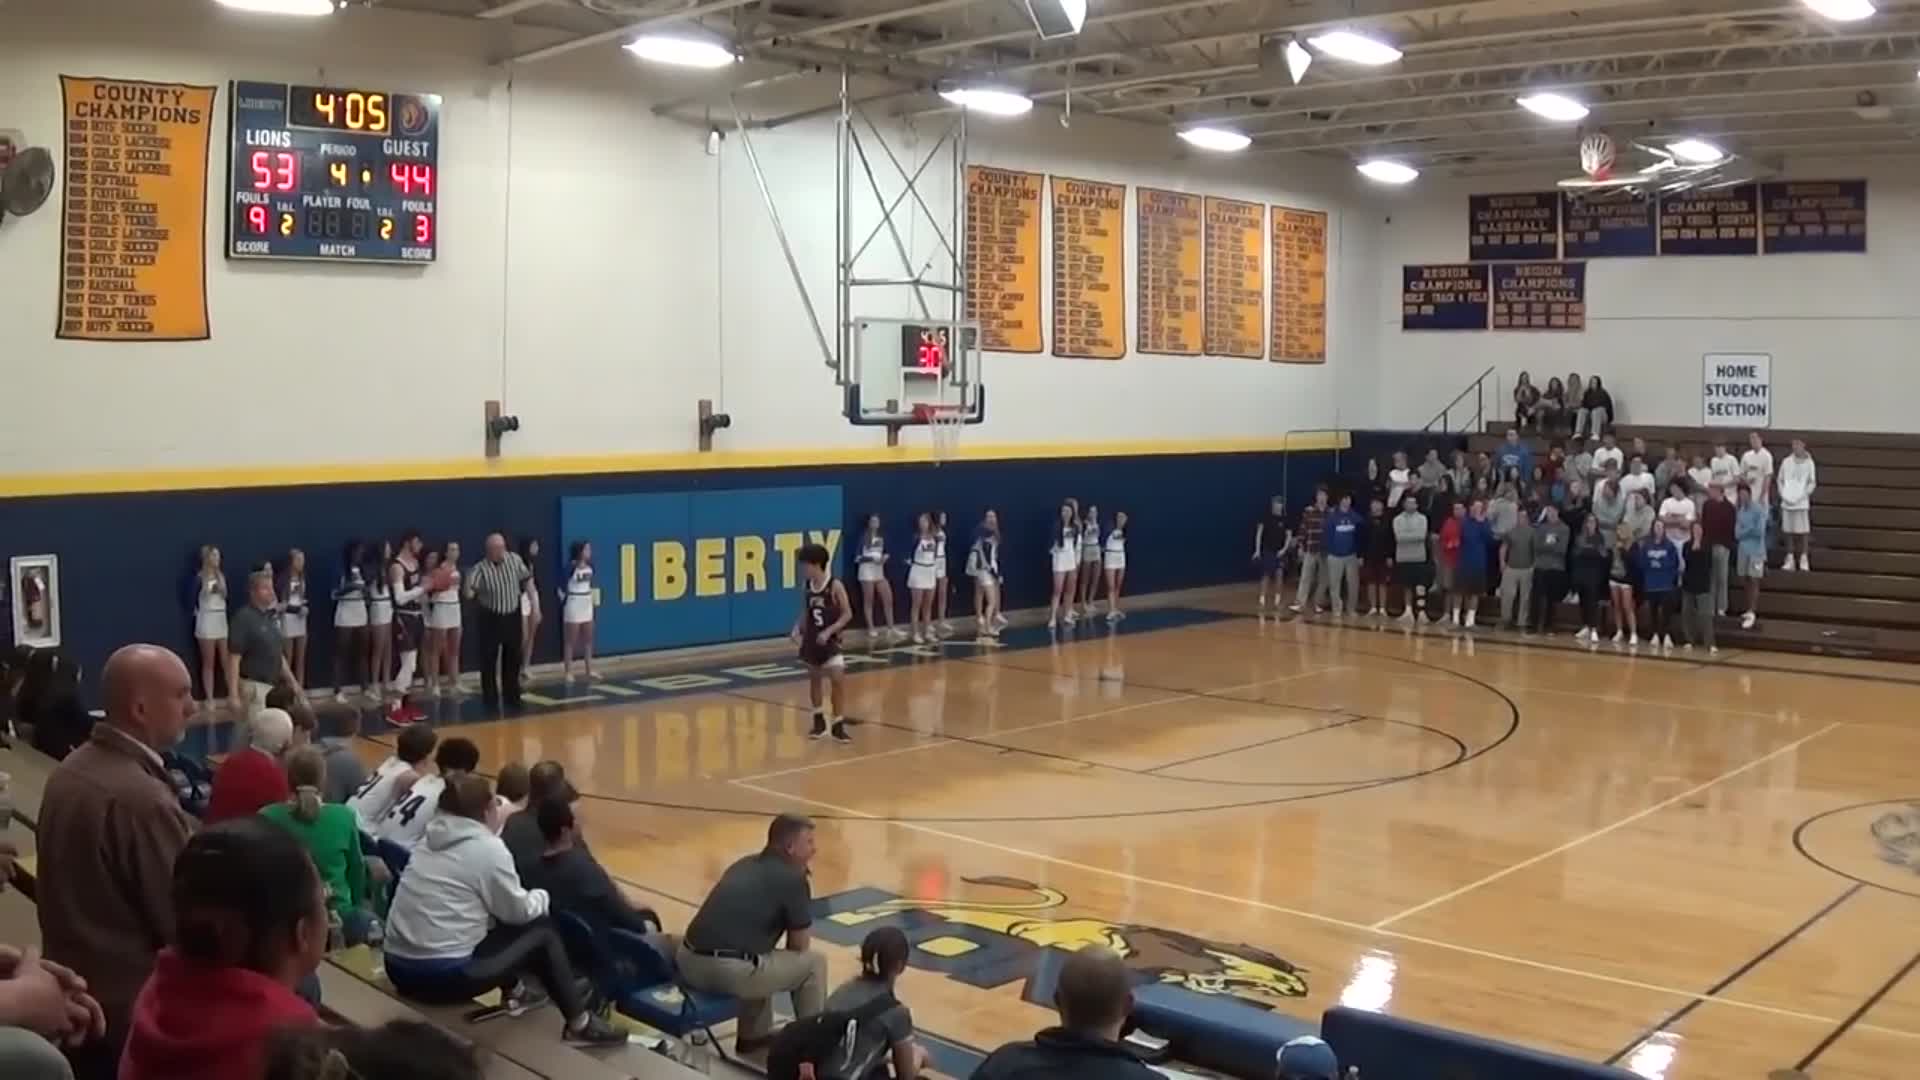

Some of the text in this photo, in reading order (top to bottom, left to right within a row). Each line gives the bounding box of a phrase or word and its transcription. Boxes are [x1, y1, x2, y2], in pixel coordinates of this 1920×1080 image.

[94, 84, 184, 105] COUNTY
[75, 102, 200, 124] CHAMPIONS
[246, 129, 291, 147] LIONS
[320, 143, 357, 156] PERIOD
[383, 139, 430, 157] GUEST
[252, 151, 294, 189] 53
[330, 163, 347, 186] 4
[391, 163, 430, 194] 44
[978, 170, 1028, 186] COUNTY
[236, 191, 270, 204] FOULS
[970, 183, 1037, 201] CHAMPIONS
[1066, 182, 1111, 198] COUNTY
[303, 195, 371, 210] PLAYER FOUL
[402, 200, 433, 212] FOULS
[1057, 194, 1119, 210] CHAMPIONS
[1667, 201, 1749, 212] CHAMPIONS
[250, 206, 265, 233] 9
[280, 213, 293, 235] 2
[1479, 221, 1548, 233] BASEBALL
[380, 219, 393, 240] 2
[416, 215, 429, 242] 3
[236, 241, 270, 253] SCORE
[319, 243, 355, 256] MATCH
[401, 247, 432, 259] SCORE
[1422, 267, 1469, 278] REGION
[1515, 265, 1562, 277] REGION
[1410, 280, 1482, 291] CHAMPIONS
[1502, 278, 1576, 289] CHAMPIONS
[1499, 291, 1579, 301] VOLLEYBALL
[1716, 365, 1758, 378] HOME
[1705, 384, 1768, 397] STUDENT
[1707, 403, 1766, 416] SECTION
[592, 529, 842, 607] IBERTY
